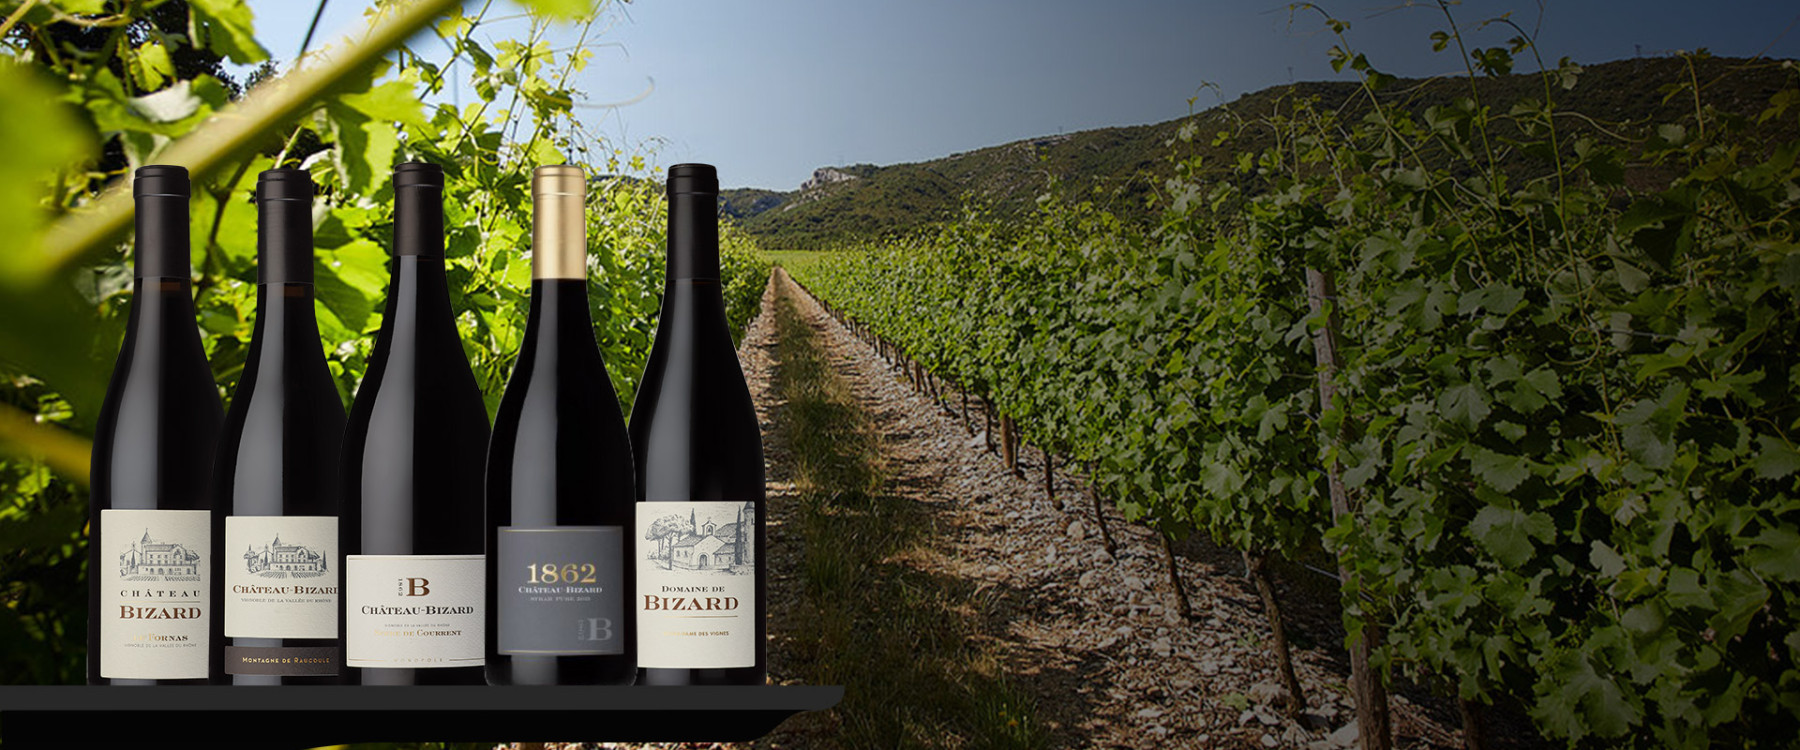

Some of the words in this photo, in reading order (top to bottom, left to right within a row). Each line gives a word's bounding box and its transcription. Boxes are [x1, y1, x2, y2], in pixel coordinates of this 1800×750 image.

[527, 563, 597, 584] 1862
[120, 589, 201, 598] CHÂTEAU
[406, 577, 430, 597] B
[661, 585, 709, 593] DOMAINE
[361, 604, 474, 615] CHÂTEAU-BIZARD
[643, 594, 739, 611] BIZARD
[120, 605, 202, 620] BIZARD
[417, 629, 462, 637] COURRENT
[587, 617, 612, 641] B
